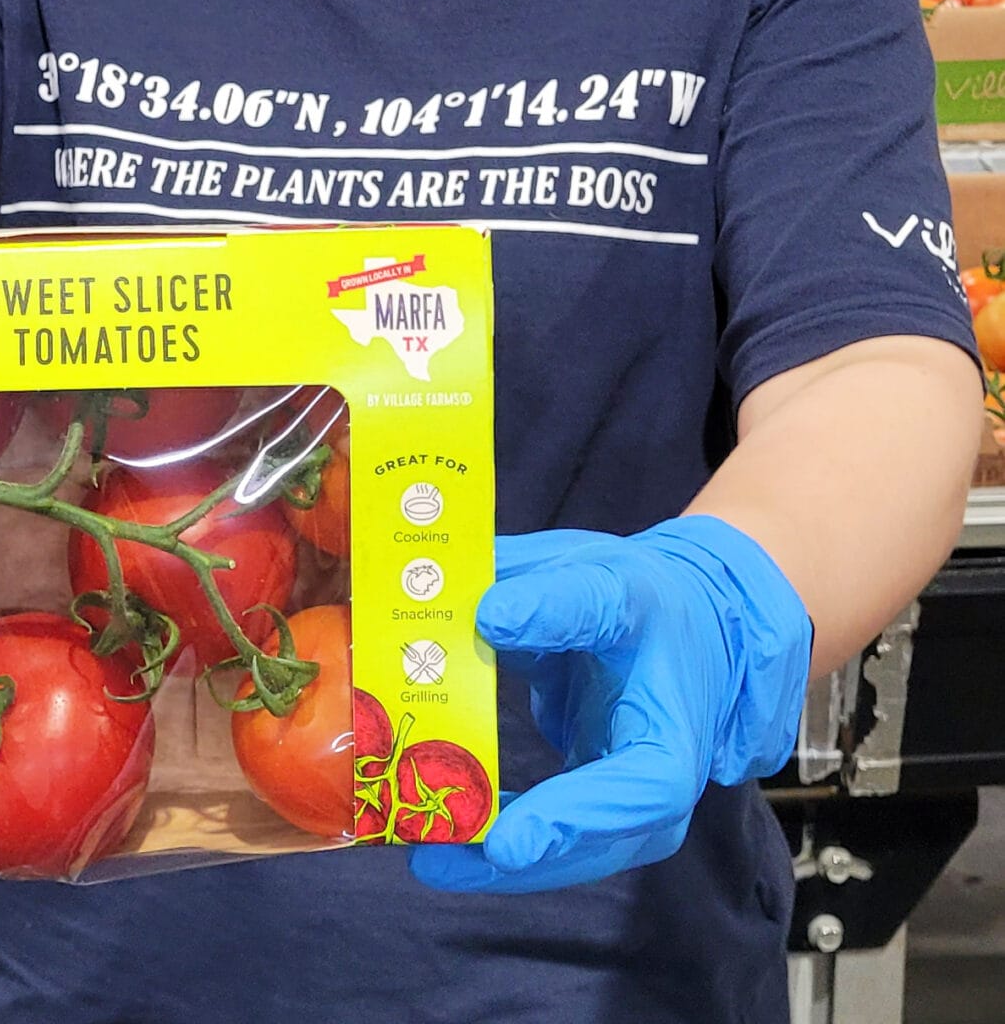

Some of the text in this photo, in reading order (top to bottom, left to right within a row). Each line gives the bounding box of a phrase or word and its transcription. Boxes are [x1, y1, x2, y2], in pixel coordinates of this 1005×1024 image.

[151, 157, 228, 197] THE
[230, 164, 384, 208] PLANTS
[387, 169, 470, 208] ARE
[479, 166, 560, 206] THE
[567, 165, 658, 214] BOSS
[340, 265, 412, 290] GROWN LOCALLY IN
[113, 273, 232, 314] SLICER
[375, 293, 446, 330] MARFA
[14, 324, 200, 366] TOMATOES
[403, 336, 428, 352] TX
[367, 393, 380, 407] BY
[383, 392, 423, 407] VILLAGE
[374, 455, 468, 475] GREAT FOR
[393, 530, 449, 543] Cooking
[391, 608, 453, 621] Snacking
[400, 690, 448, 704] Grilling
